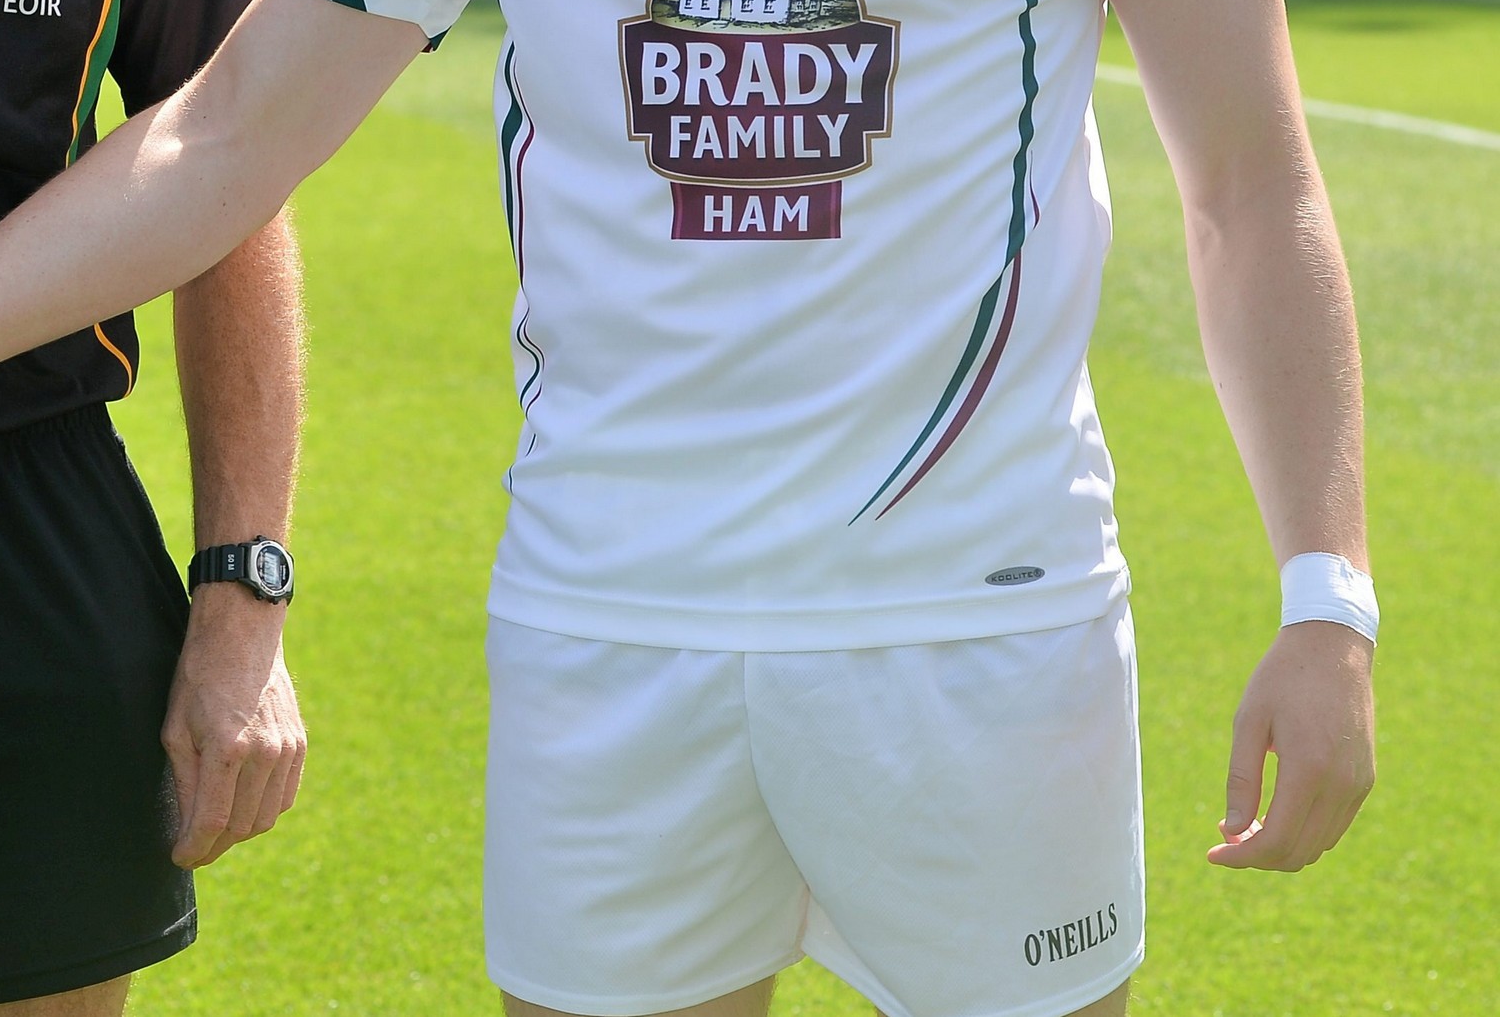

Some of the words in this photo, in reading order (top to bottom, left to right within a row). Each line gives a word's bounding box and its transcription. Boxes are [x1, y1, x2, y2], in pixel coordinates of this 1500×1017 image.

[641, 42, 878, 106] BRADY
[669, 114, 849, 159] FAMILY
[703, 195, 809, 232] HAM
[1024, 902, 1118, 967] O'NEILLS
